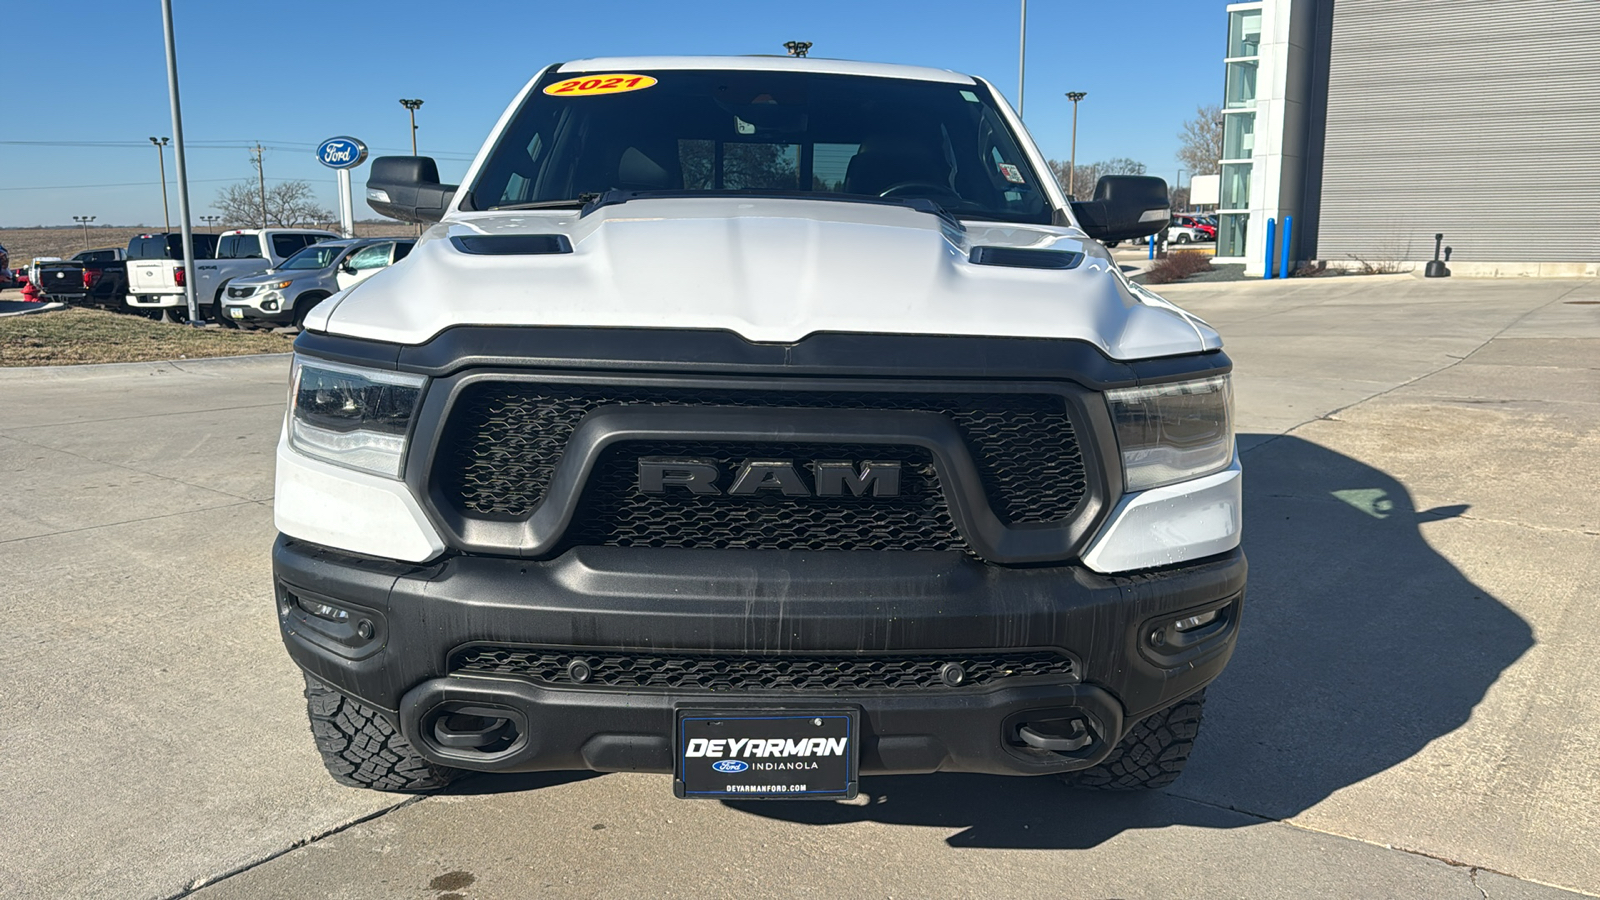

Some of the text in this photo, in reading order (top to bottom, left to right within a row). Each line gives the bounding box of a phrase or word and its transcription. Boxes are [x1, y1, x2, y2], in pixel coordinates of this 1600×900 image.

[553, 77, 643, 93] 2021
[324, 143, 351, 162] Ford
[638, 457, 901, 497] RAM
[685, 737, 848, 758] DEYARMAN
[719, 761, 819, 771] Ford INDIANOLA
[726, 784, 807, 792] DEYARMANFORD.COM
